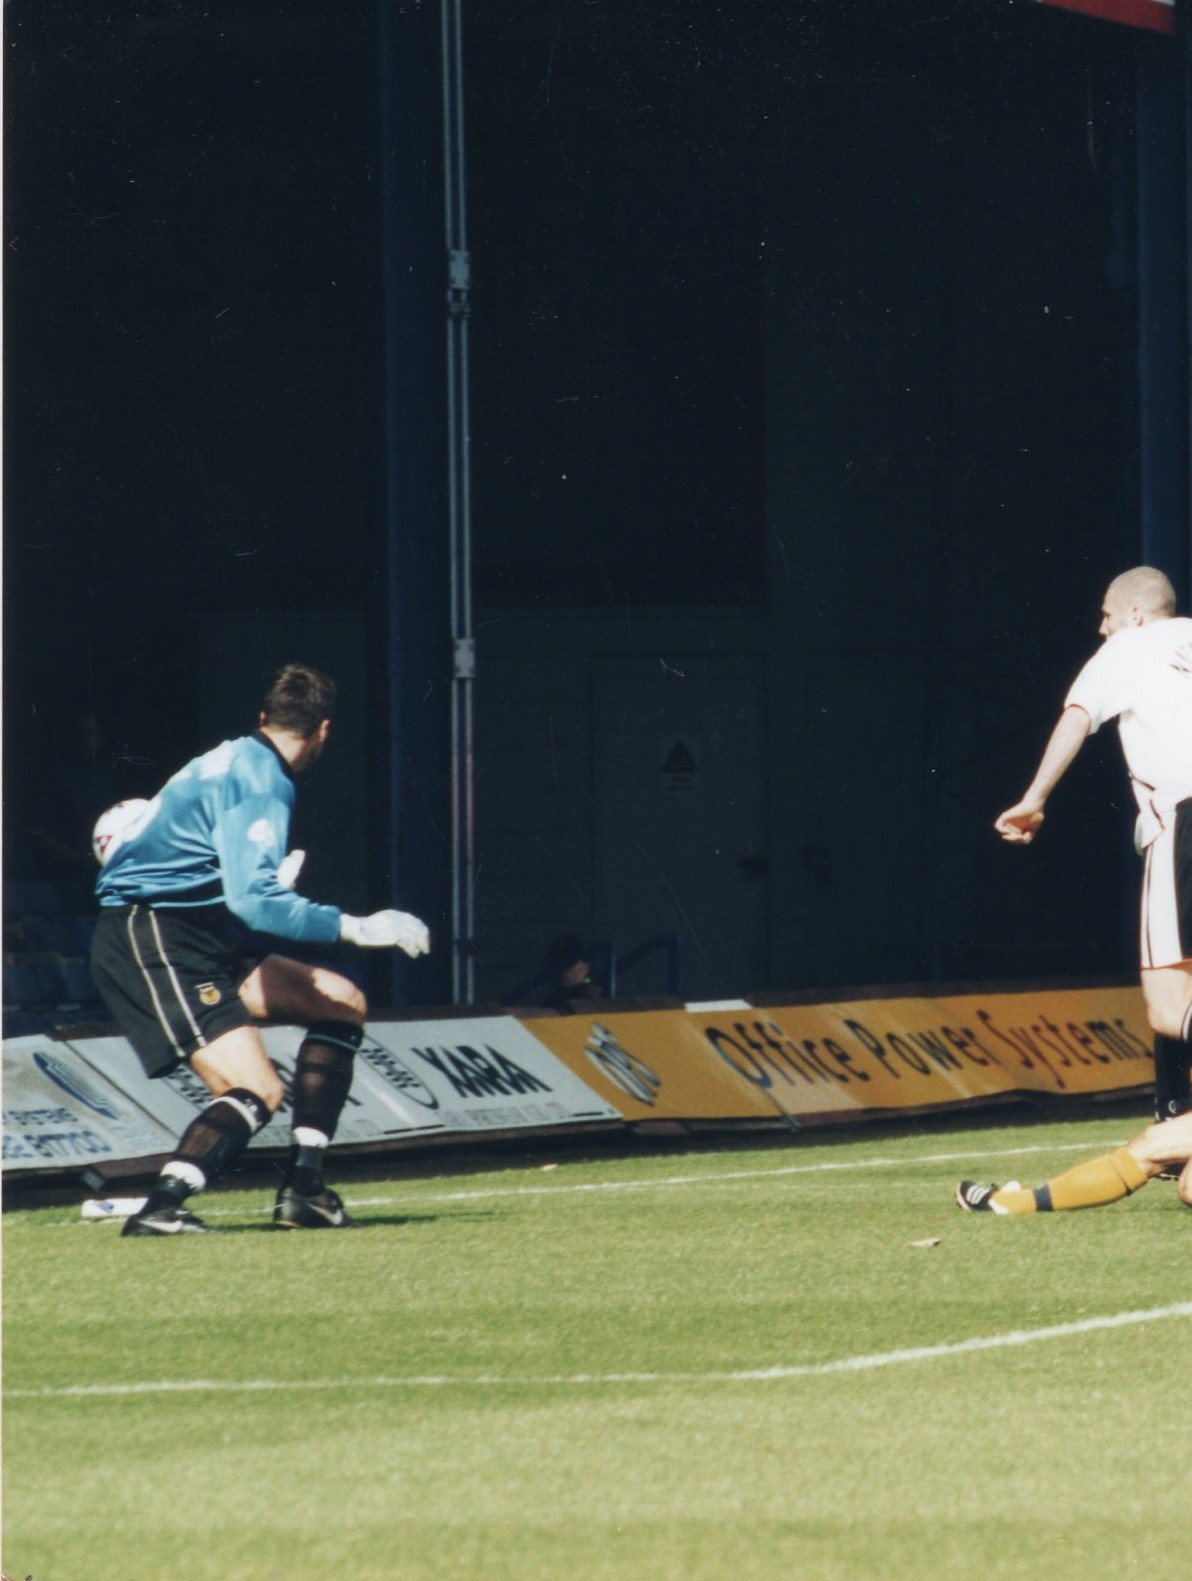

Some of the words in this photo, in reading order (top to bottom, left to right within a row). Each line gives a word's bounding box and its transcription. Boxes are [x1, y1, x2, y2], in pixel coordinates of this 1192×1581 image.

[704, 1021, 871, 1088] Office
[843, 1018, 1003, 1079] Power
[976, 1009, 1155, 1090] Systems
